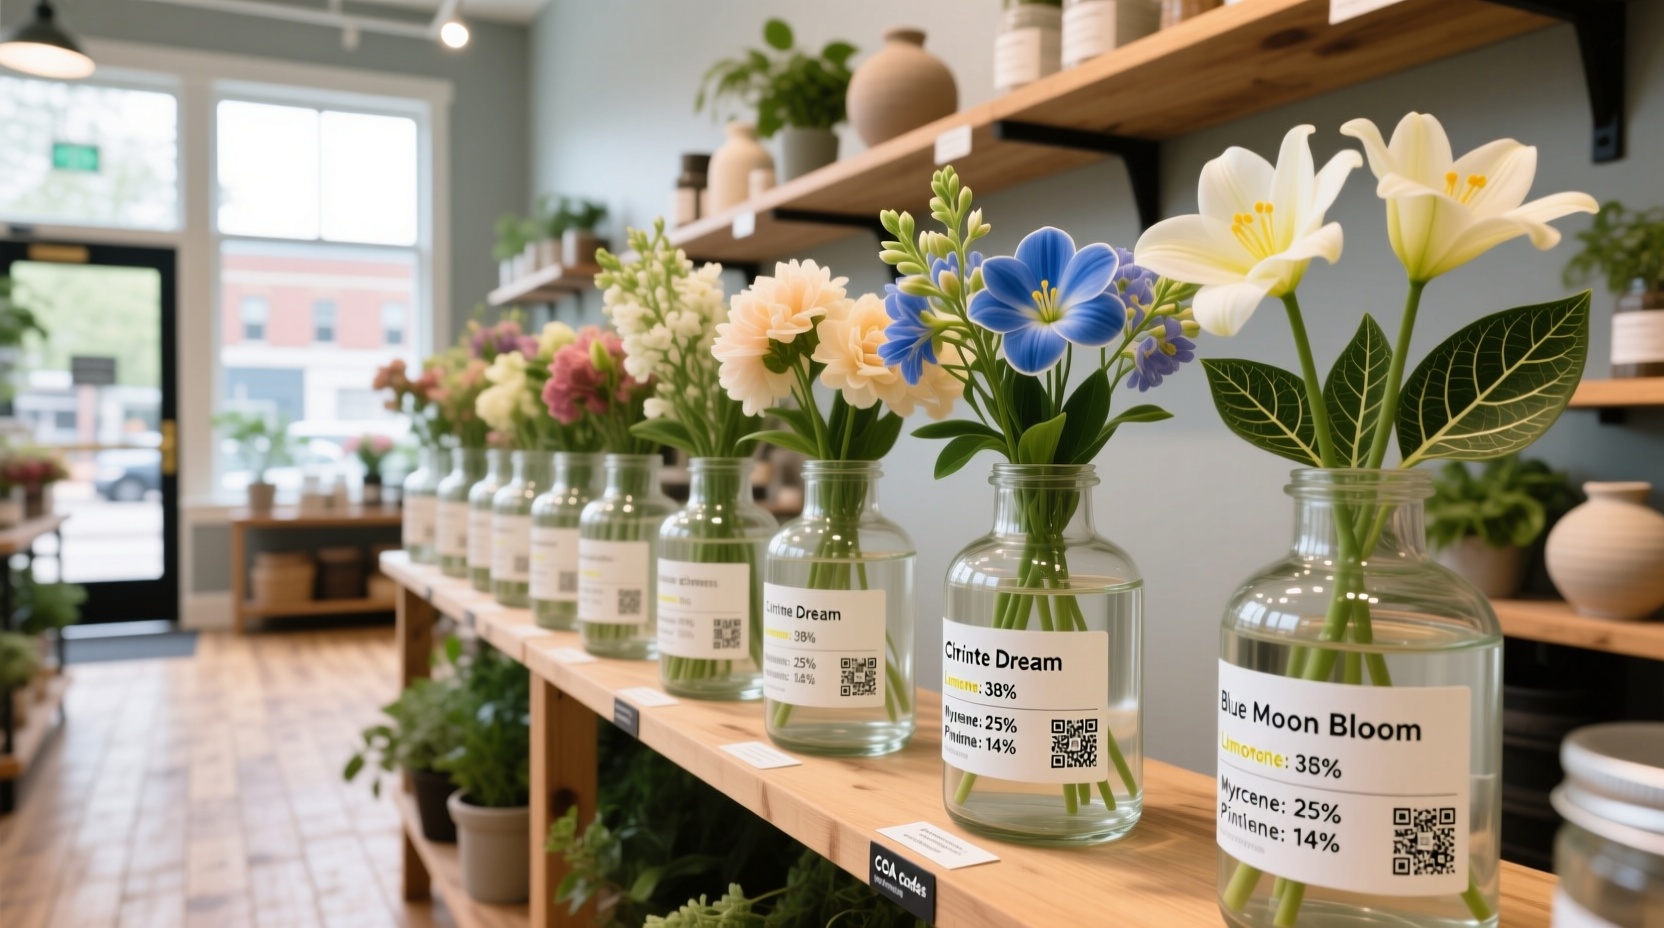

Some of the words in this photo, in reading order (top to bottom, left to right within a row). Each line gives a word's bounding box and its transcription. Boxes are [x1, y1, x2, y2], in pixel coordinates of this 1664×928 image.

[796, 605, 841, 621] Dream
[996, 649, 1062, 671] Dream
[985, 681, 1017, 700] 38%
[985, 715, 1017, 733] 25%
[1221, 689, 1247, 719] Blue
[1253, 701, 1319, 734] Moon
[1329, 713, 1422, 741] Bloom
[986, 737, 1016, 755] 14%
[1221, 774, 1285, 814] Myrcene:
[1294, 798, 1342, 824] 25%
[1294, 828, 1340, 853] 14%
[875, 855, 897, 881] COA
